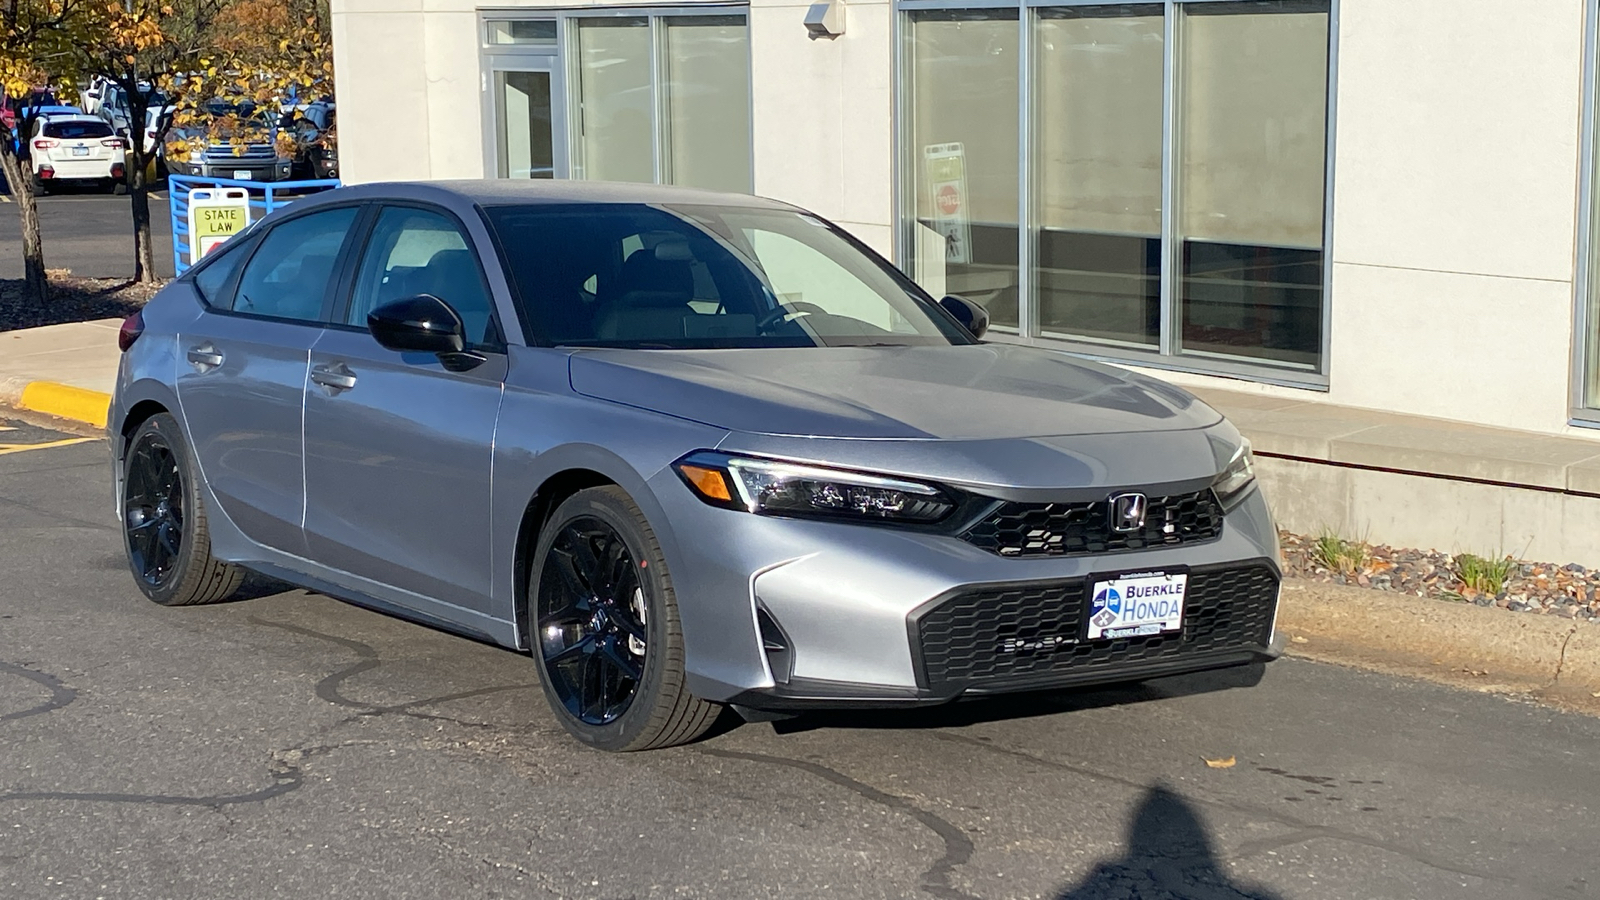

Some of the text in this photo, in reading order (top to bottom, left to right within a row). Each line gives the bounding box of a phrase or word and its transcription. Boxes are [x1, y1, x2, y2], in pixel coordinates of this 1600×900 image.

[204, 210, 237, 220] STATE
[210, 222, 233, 232] LAW
[1126, 584, 1183, 599] BUERKLE
[1123, 599, 1179, 621] HONDA
